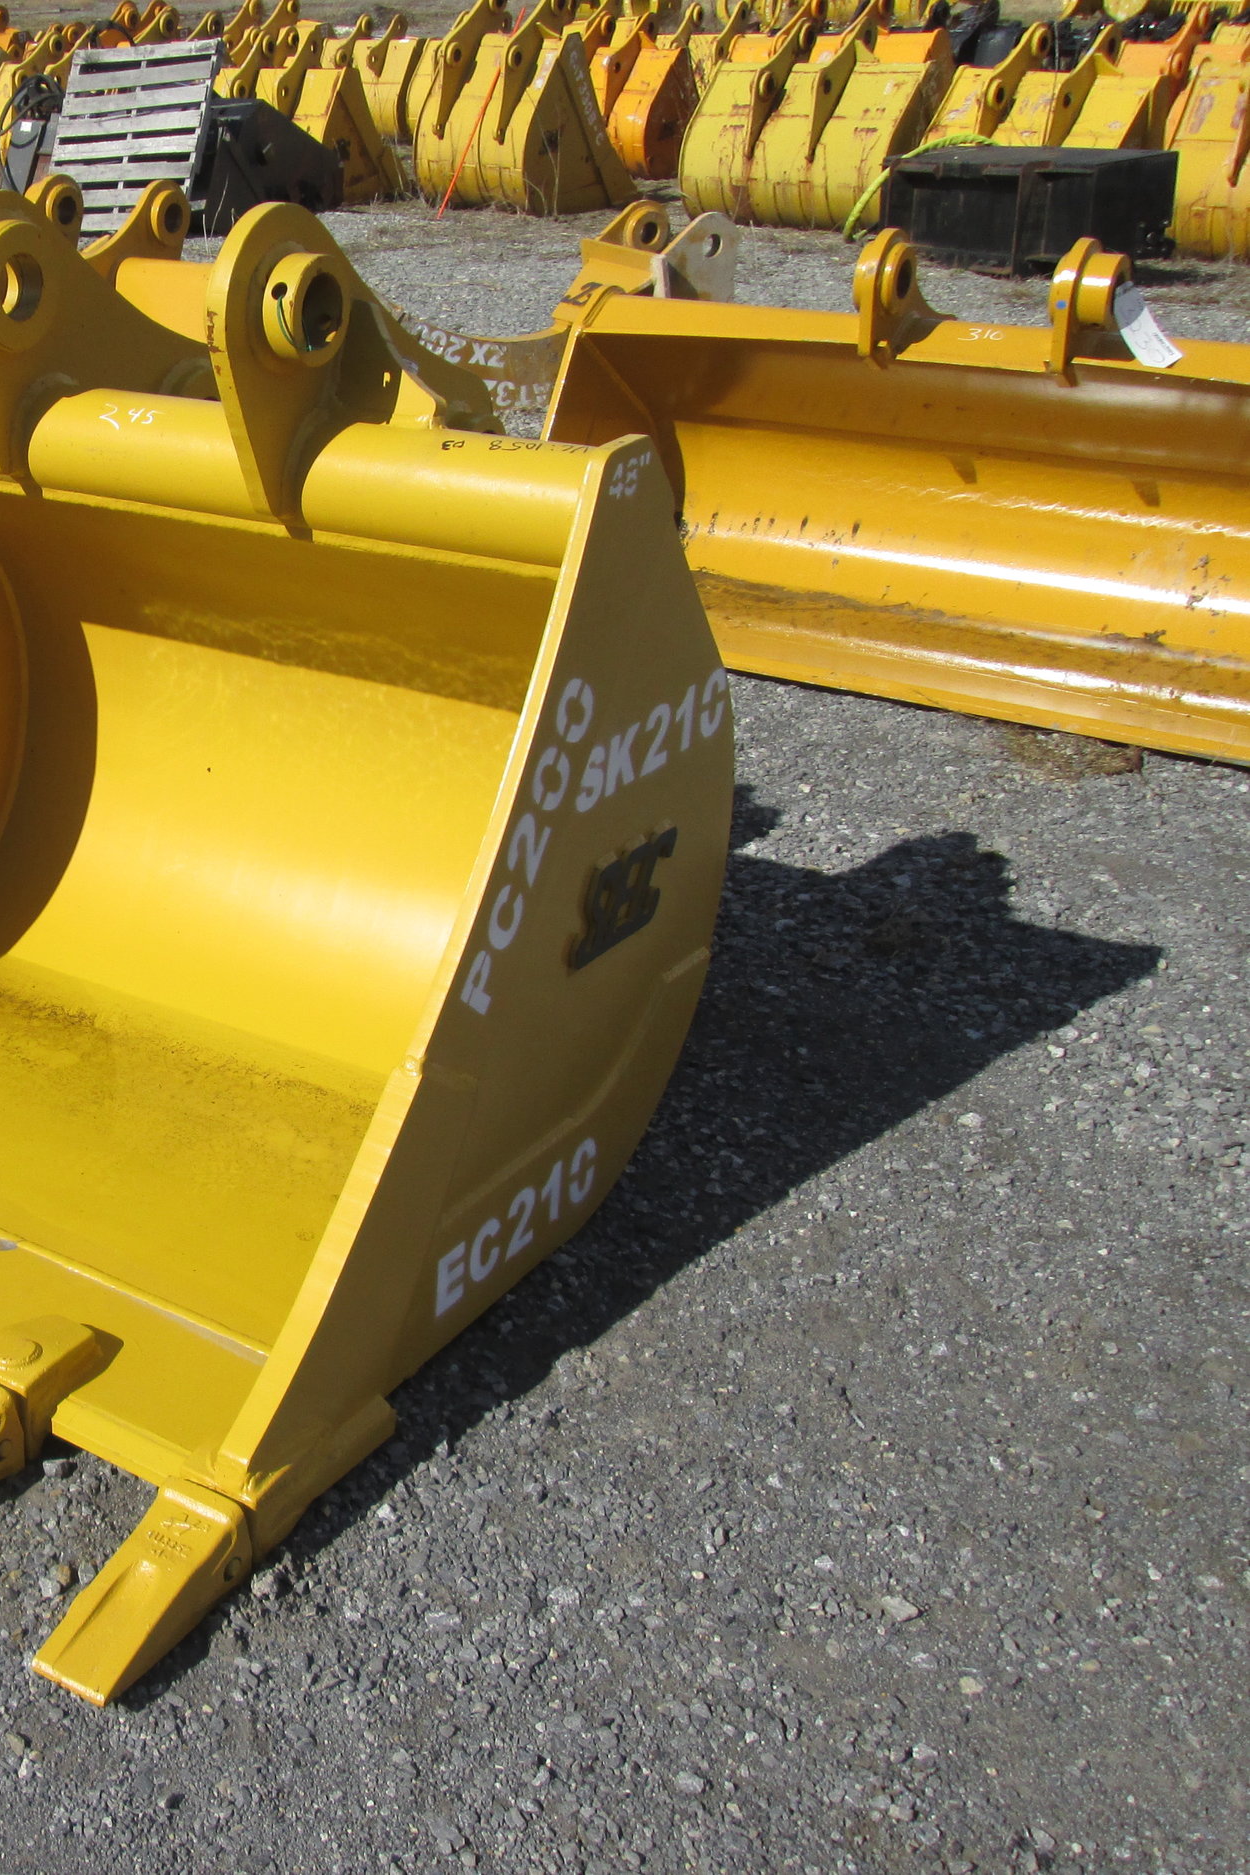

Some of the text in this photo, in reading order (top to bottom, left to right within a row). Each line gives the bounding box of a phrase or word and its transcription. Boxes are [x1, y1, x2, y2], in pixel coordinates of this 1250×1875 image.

[958, 327, 1005, 341] 310
[576, 667, 728, 813] SK210
[461, 678, 594, 1016] PC200
[435, 1137, 597, 1317] EC210
